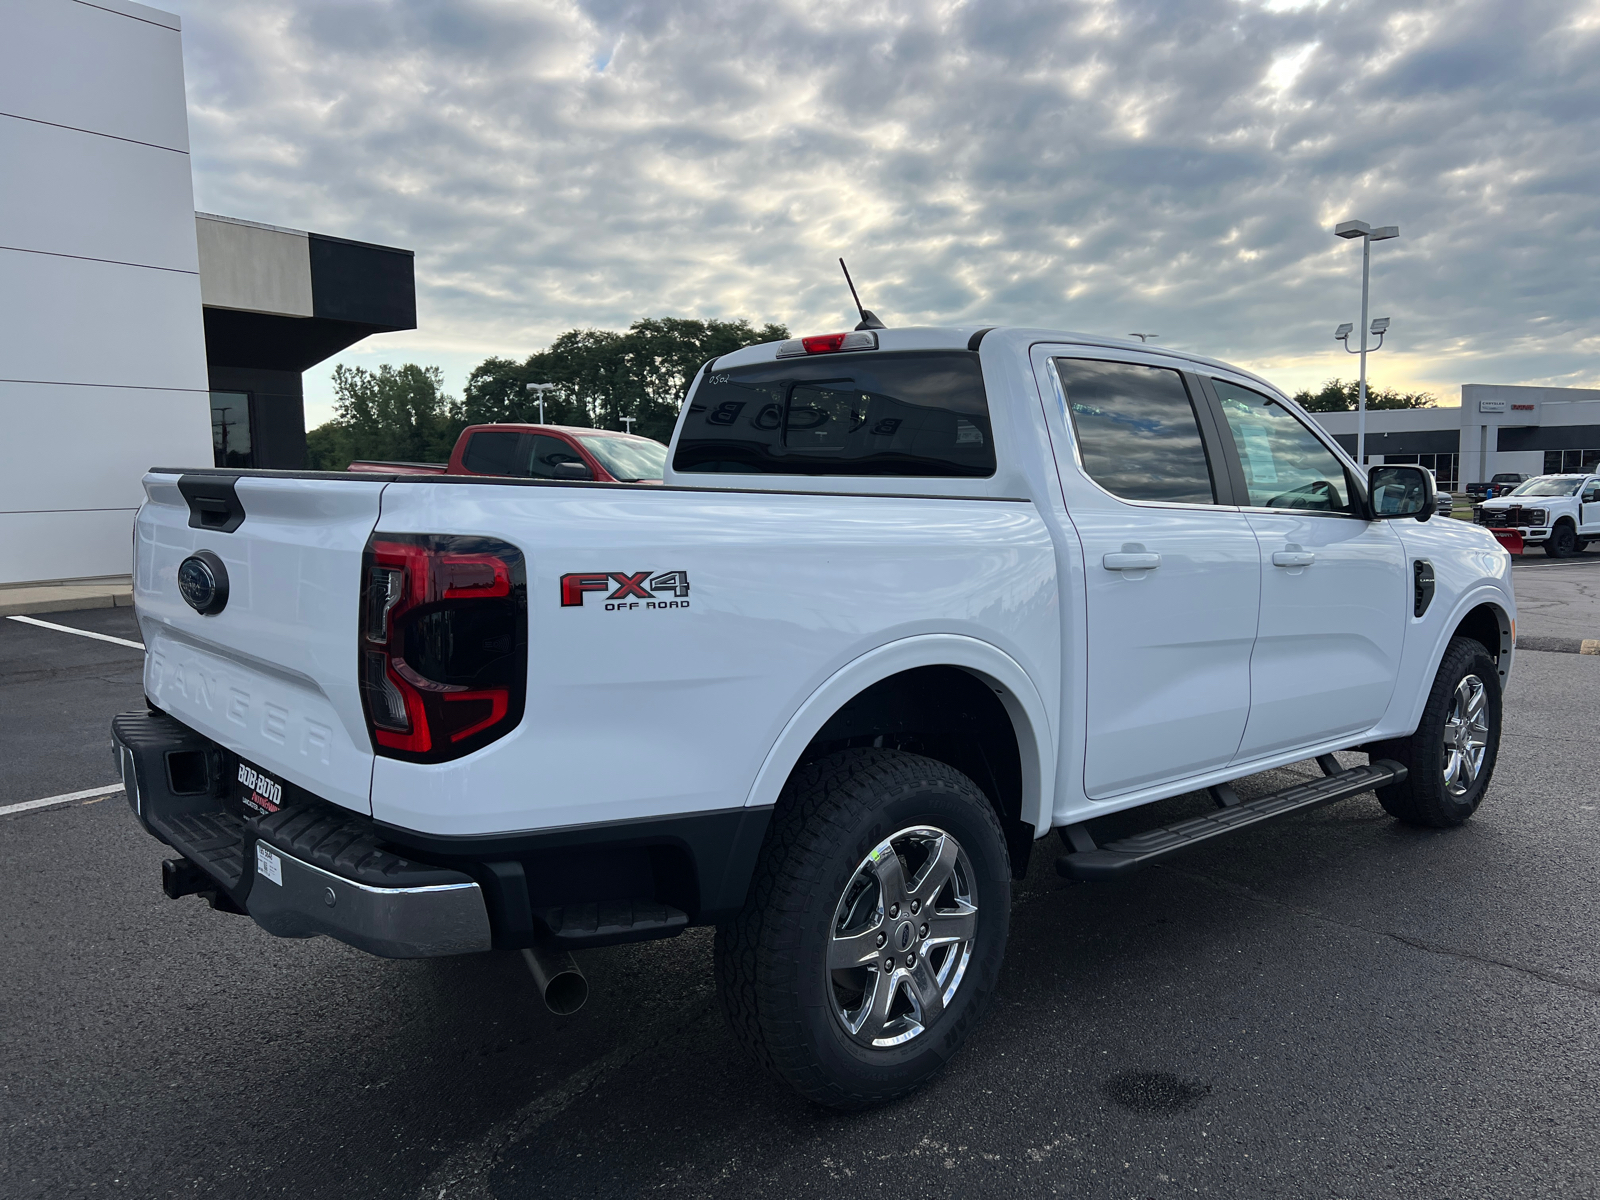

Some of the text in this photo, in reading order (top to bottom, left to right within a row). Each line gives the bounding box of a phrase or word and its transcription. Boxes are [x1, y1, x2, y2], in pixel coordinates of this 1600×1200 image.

[560, 570, 690, 607] FX4
[605, 600, 690, 611] OFF ROAD
[151, 649, 333, 766] RANGER
